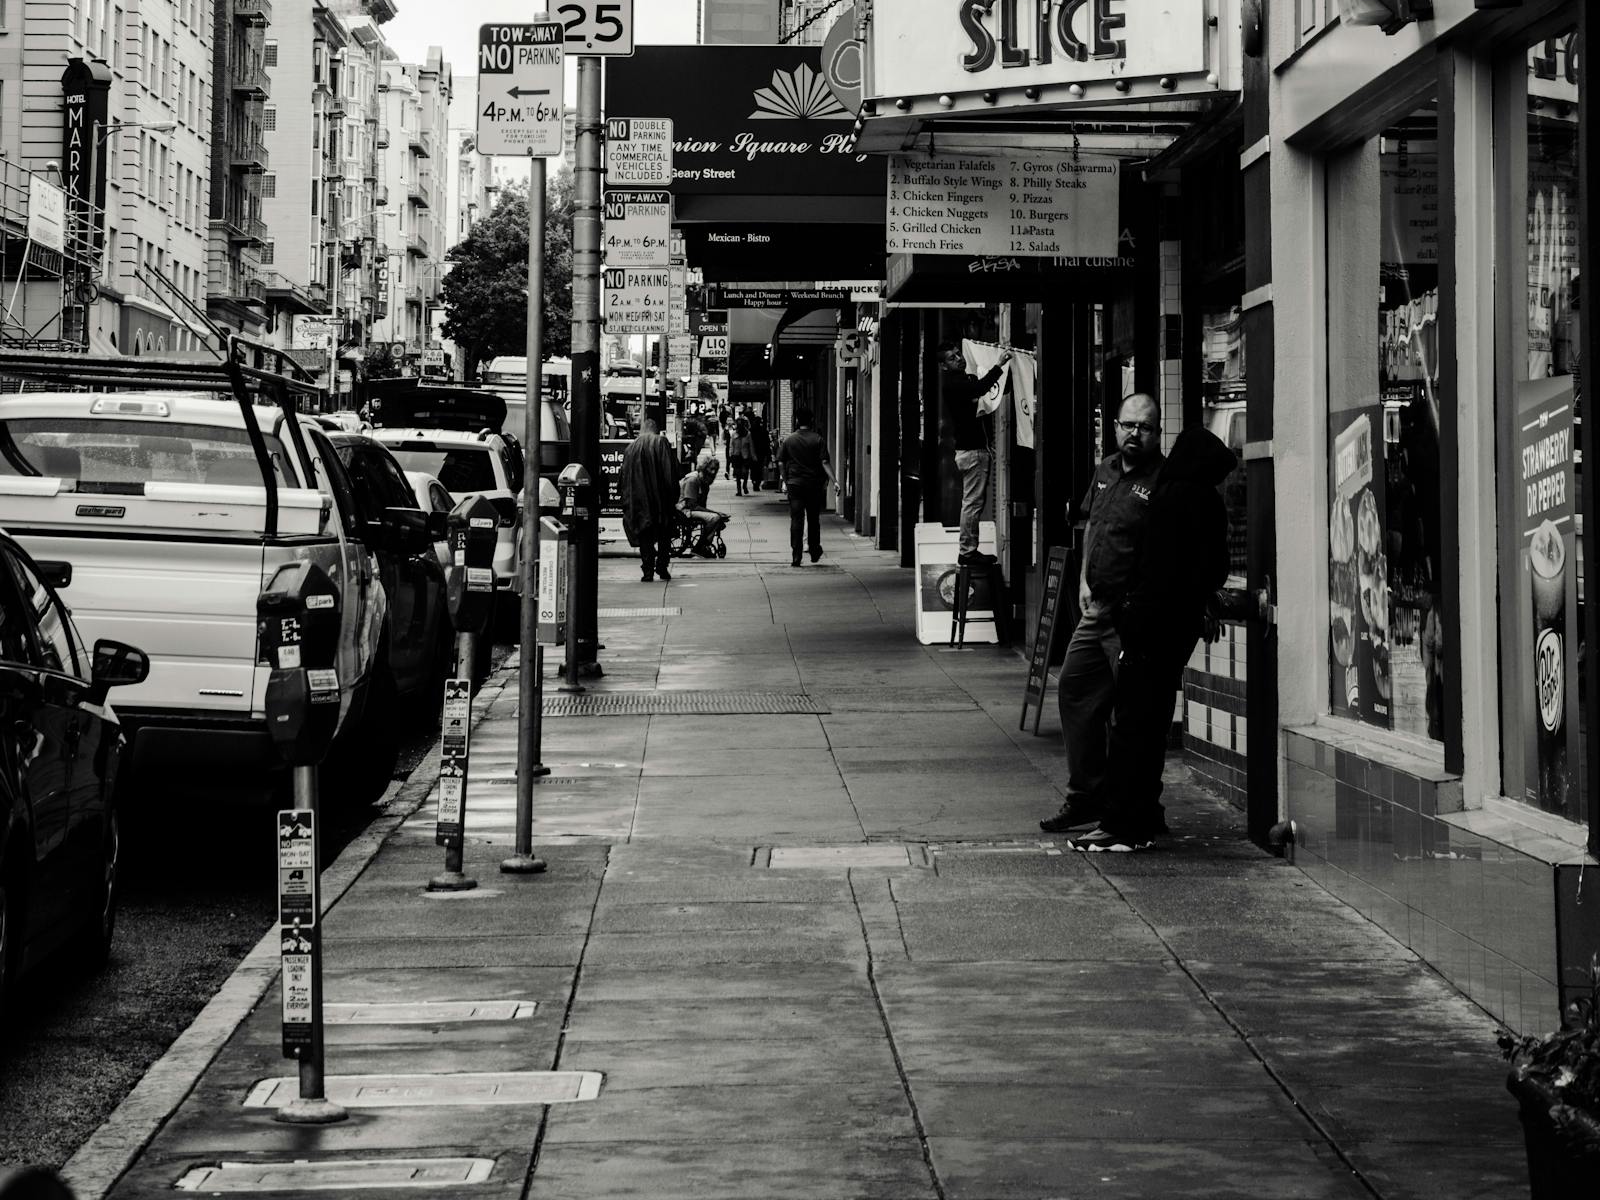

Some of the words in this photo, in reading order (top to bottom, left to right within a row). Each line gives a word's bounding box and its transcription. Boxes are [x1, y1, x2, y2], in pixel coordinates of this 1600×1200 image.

[557, 4, 624, 42] 25
[490, 26, 558, 42] TOW-AWAY
[481, 44, 512, 69] NO
[519, 47, 561, 65] PARKING
[67, 94, 86, 104] HOTEL
[609, 121, 627, 138] NO
[633, 121, 667, 130] DOUBLE
[633, 131, 667, 140] PARKING
[616, 143, 638, 152] ANY
[641, 143, 663, 152] TIME
[729, 133, 813, 161] Square
[609, 152, 669, 161] COMMERCIAL
[616, 162, 663, 171] VEHICLES
[891, 159, 900, 168] 1.
[904, 159, 956, 172] Vegetarian
[959, 160, 996, 170] Falafels
[1010, 161, 1020, 172] 7.
[1023, 161, 1054, 175] Gyros
[1056, 162, 1117, 176] (Shawarma)
[615, 171, 663, 180] INCLUDED
[671, 169, 701, 180] Geary
[702, 168, 736, 179] Street
[890, 174, 900, 184] 2.
[903, 174, 941, 186] Buffalo
[943, 175, 969, 189] Style
[971, 176, 1003, 191] Wings
[1009, 177, 1020, 187] 8.
[1023, 177, 1053, 191] Philly
[1055, 177, 1088, 189] Steaks
[611, 193, 664, 202] TOW-AWAY
[890, 190, 900, 200] 3.
[903, 190, 944, 201] Chicken
[947, 191, 984, 206] Fingers
[1009, 193, 1020, 203] 9.
[1023, 193, 1053, 204] Pizzas
[606, 203, 625, 218] NO
[627, 205, 666, 216] PARKING
[889, 206, 900, 216] 4.
[902, 206, 943, 217] Chicken
[946, 207, 989, 221] Nuggets
[1010, 209, 1027, 220] 10.
[1029, 209, 1070, 224] Burgers
[889, 222, 899, 232] 5.
[902, 222, 938, 233] Grilled
[940, 223, 982, 234] Chicken
[1029, 225, 1055, 236] Pasta
[707, 232, 741, 243] Mexican
[747, 233, 770, 243] Bistro
[889, 238, 899, 248] 6.
[902, 238, 936, 249] French
[939, 239, 965, 250] Fries
[1010, 241, 1025, 251] 12.
[1028, 241, 1060, 252] Salads
[1085, 255, 1135, 268] cuisine
[606, 270, 624, 288] NO
[628, 274, 668, 287] PARKING
[723, 291, 743, 299] Lunch
[745, 291, 758, 299] and
[759, 291, 782, 299] Dinner
[790, 291, 820, 299] Weekend
[821, 291, 844, 299] Brunch
[744, 299, 766, 307] Happy
[609, 311, 624, 322] MON
[654, 311, 666, 322] SAT
[633, 325, 665, 333] CLEANING
[706, 339, 727, 349] LIQ
[1522, 427, 1570, 480] STRAWBERRY
[1527, 483, 1538, 517] DR
[1538, 470, 1566, 513] PEPPER
